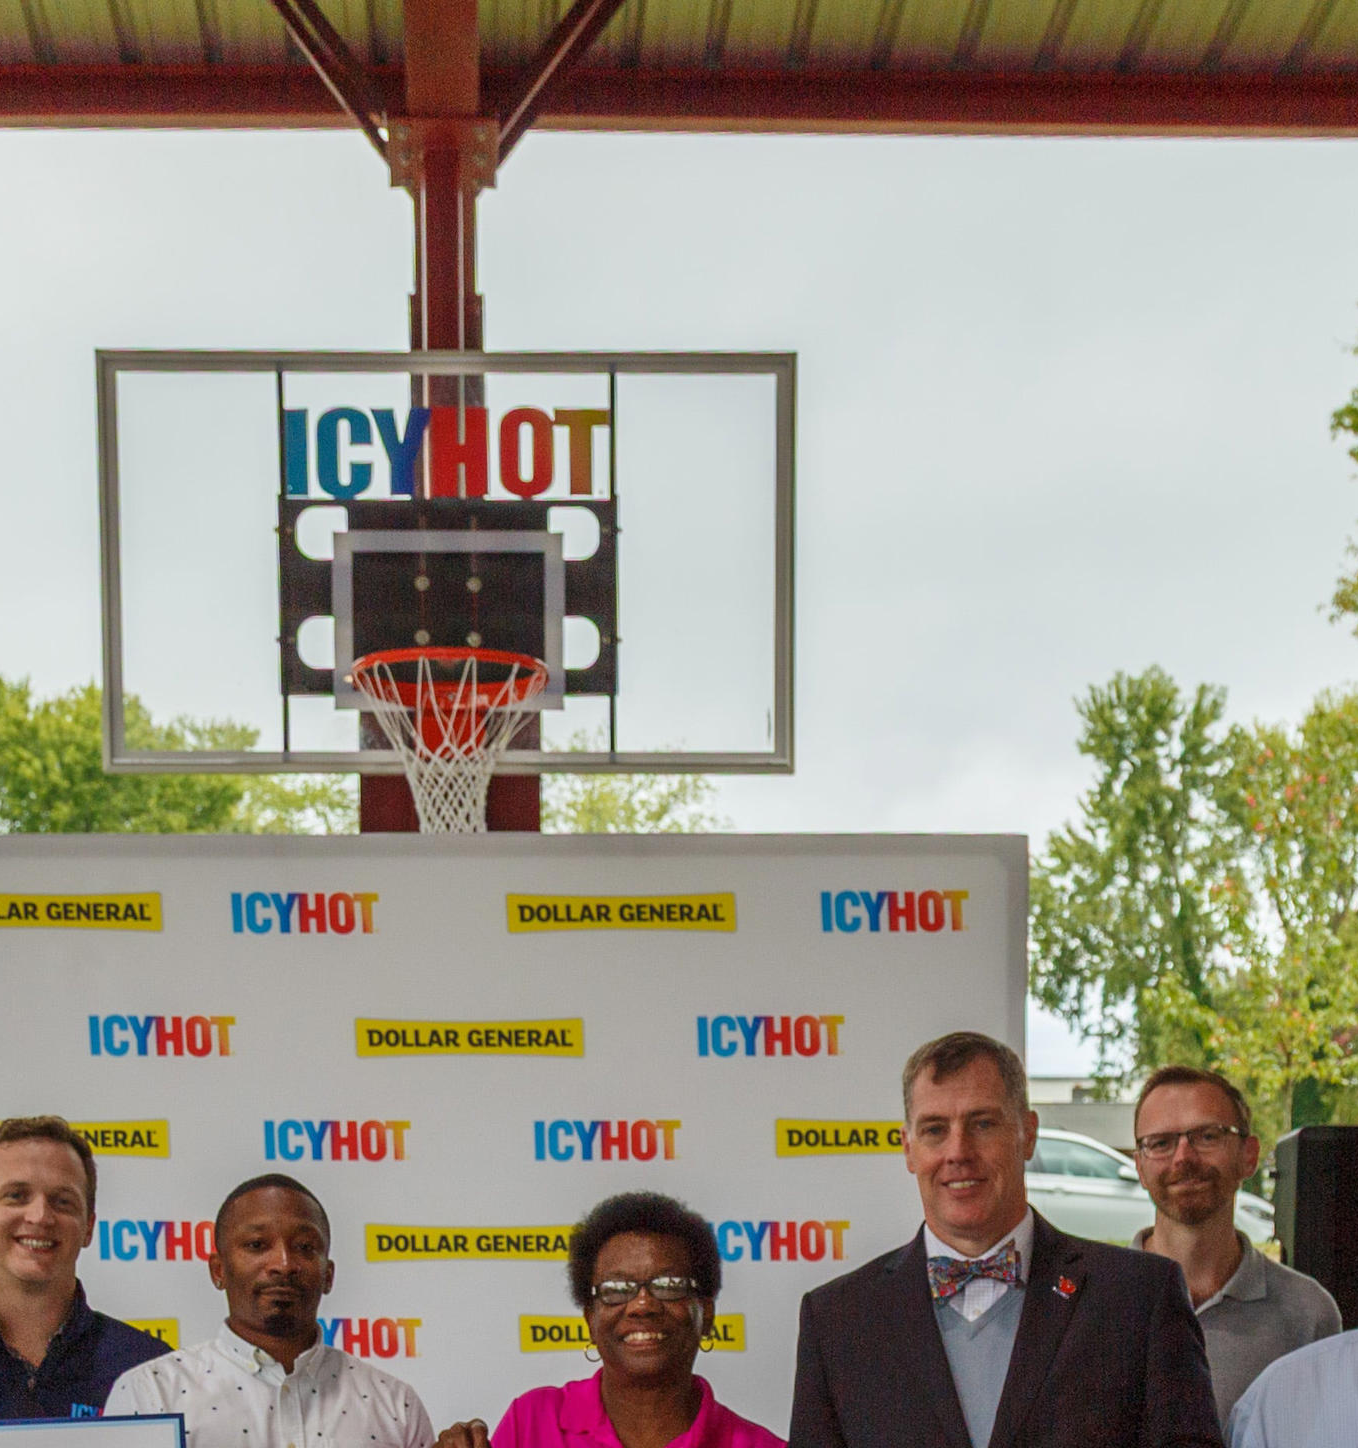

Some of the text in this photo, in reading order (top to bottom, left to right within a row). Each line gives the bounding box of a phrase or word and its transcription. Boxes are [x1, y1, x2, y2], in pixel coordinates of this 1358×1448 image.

[283, 405, 610, 499] ICYHOT
[46, 902, 151, 921] GENERAL
[231, 892, 379, 934] ICYHOT
[518, 904, 725, 923] DOLLAR GENERAL
[820, 890, 969, 933] ICYHOT
[88, 1015, 236, 1057] ICYHOT
[368, 1029, 573, 1049] DOLLAR GENERAL
[697, 1015, 845, 1057] ICYHOT
[78, 1129, 159, 1148] NERAL
[263, 1120, 411, 1162] ICYHOT
[533, 1119, 682, 1161] ICYHOT
[787, 1129, 879, 1147] DOLLAR
[99, 1219, 217, 1261] ICYHO
[376, 1235, 569, 1252] DOLLAR GENERA
[317, 1317, 422, 1358] YHOT
[531, 1325, 589, 1342] DOLL
